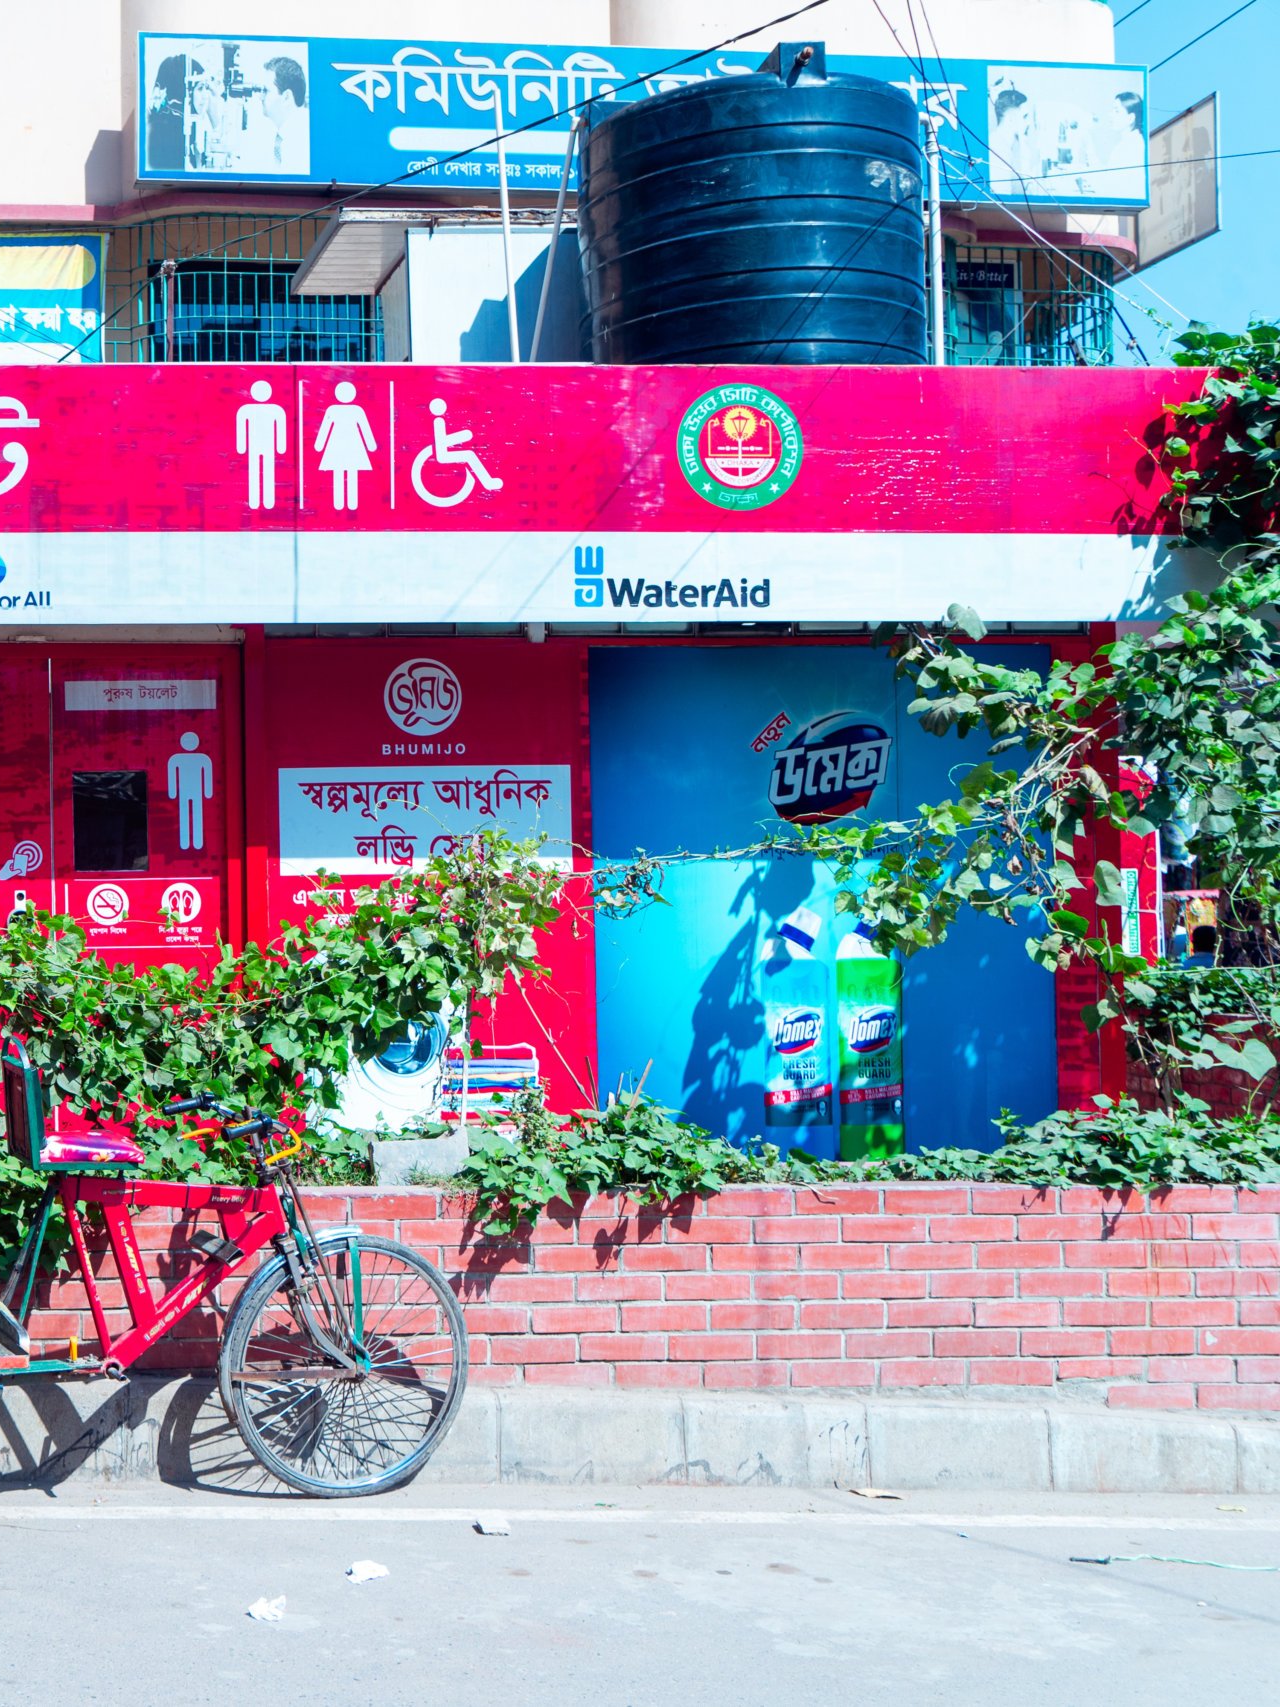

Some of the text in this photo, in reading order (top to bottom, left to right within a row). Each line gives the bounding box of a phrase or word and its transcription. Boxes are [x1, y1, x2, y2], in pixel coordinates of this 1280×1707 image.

[331, 47, 626, 119] কমিউনিটি
[23, 591, 53, 610] All
[606, 577, 770, 608] WaterAid
[138, 684, 178, 700] টয়লেট
[750, 711, 792, 752] নতুন
[382, 743, 466, 755] BHUMIJO
[768, 737, 893, 805] ডমেক্স
[298, 768, 552, 821] স্বল্পমূল্যে আধুনিক
[773, 1018, 821, 1046] Domex
[848, 1018, 897, 1045] Domex
[783, 1059, 815, 1069] FRESH
[858, 1058, 890, 1068] FRESH
[858, 1069, 890, 1079] GUARD
[783, 1070, 815, 1080] GUARD
